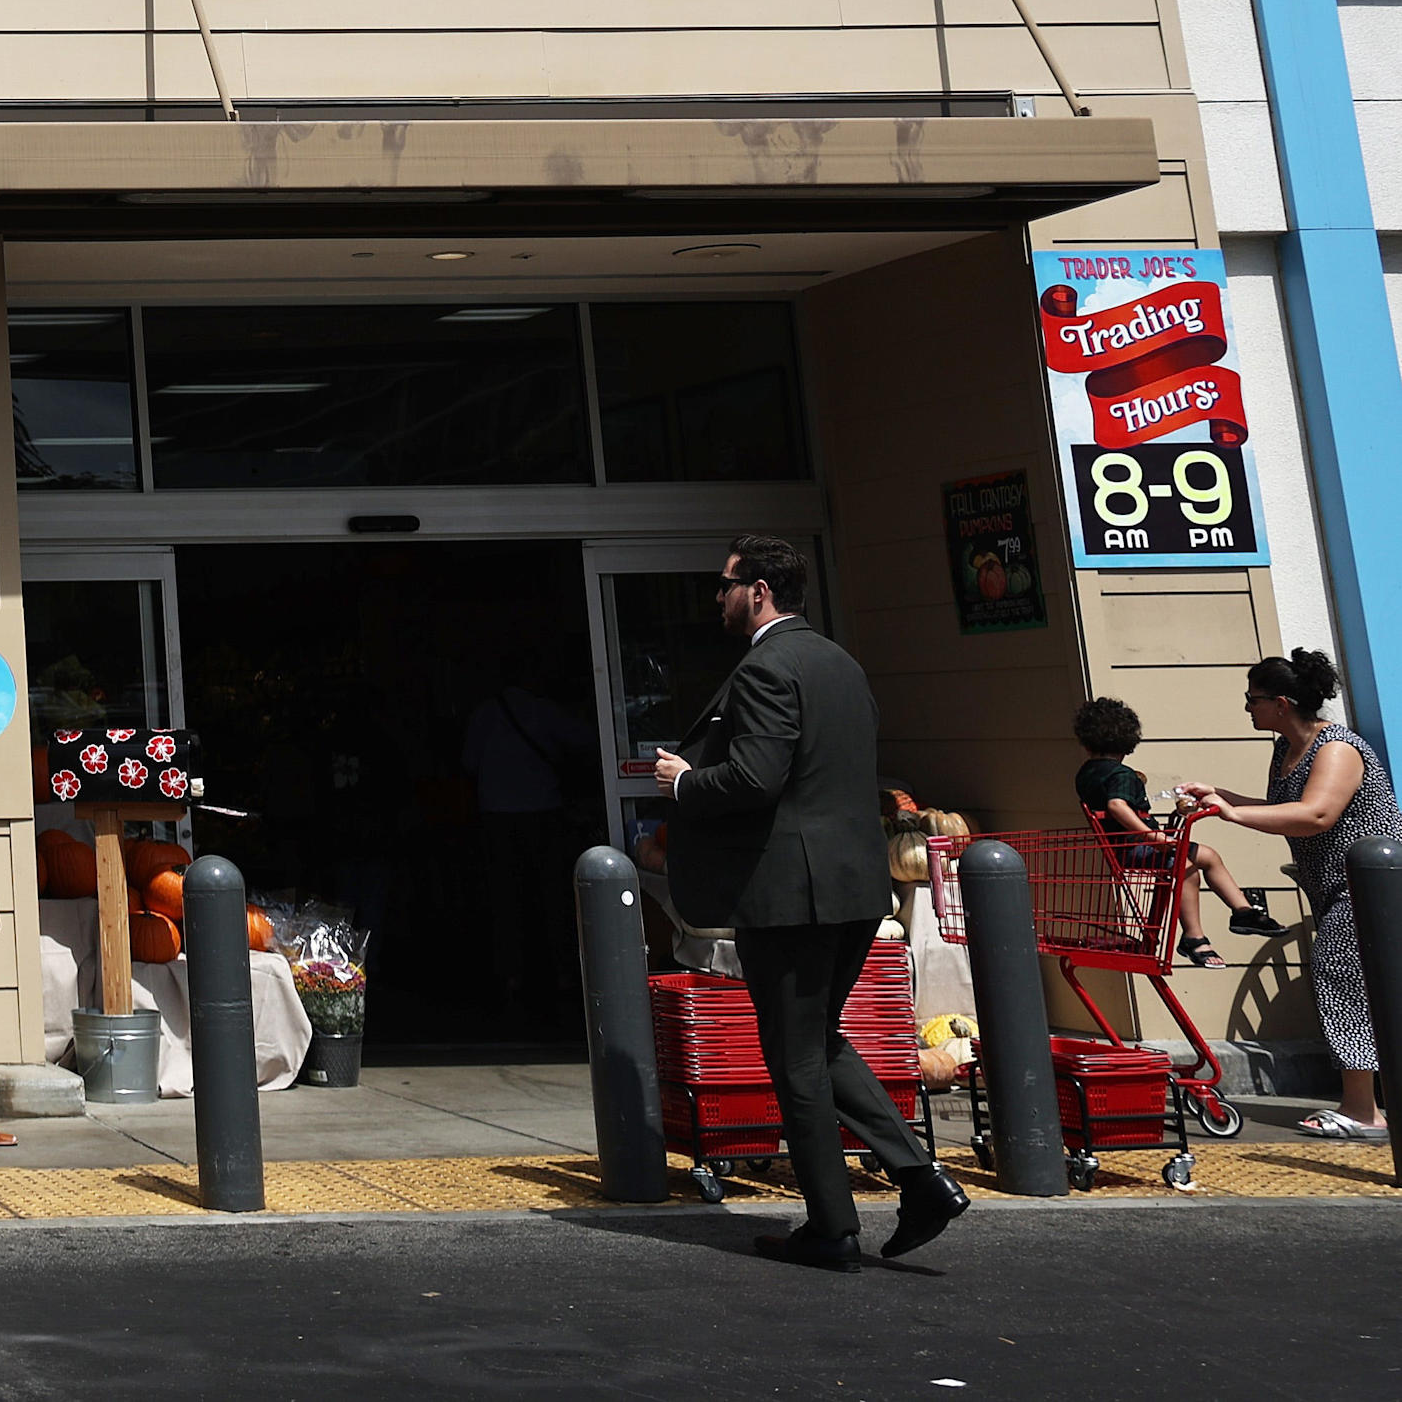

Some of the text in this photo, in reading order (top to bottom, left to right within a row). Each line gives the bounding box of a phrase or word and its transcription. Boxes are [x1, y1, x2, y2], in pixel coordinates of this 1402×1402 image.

[1058, 255, 1197, 280] TRADER JOE'S
[1060, 298, 1205, 357] Trading
[1110, 381, 1220, 433] Hours:
[1091, 450, 1233, 527] 8-9
[1104, 527, 1234, 549] AM PM
